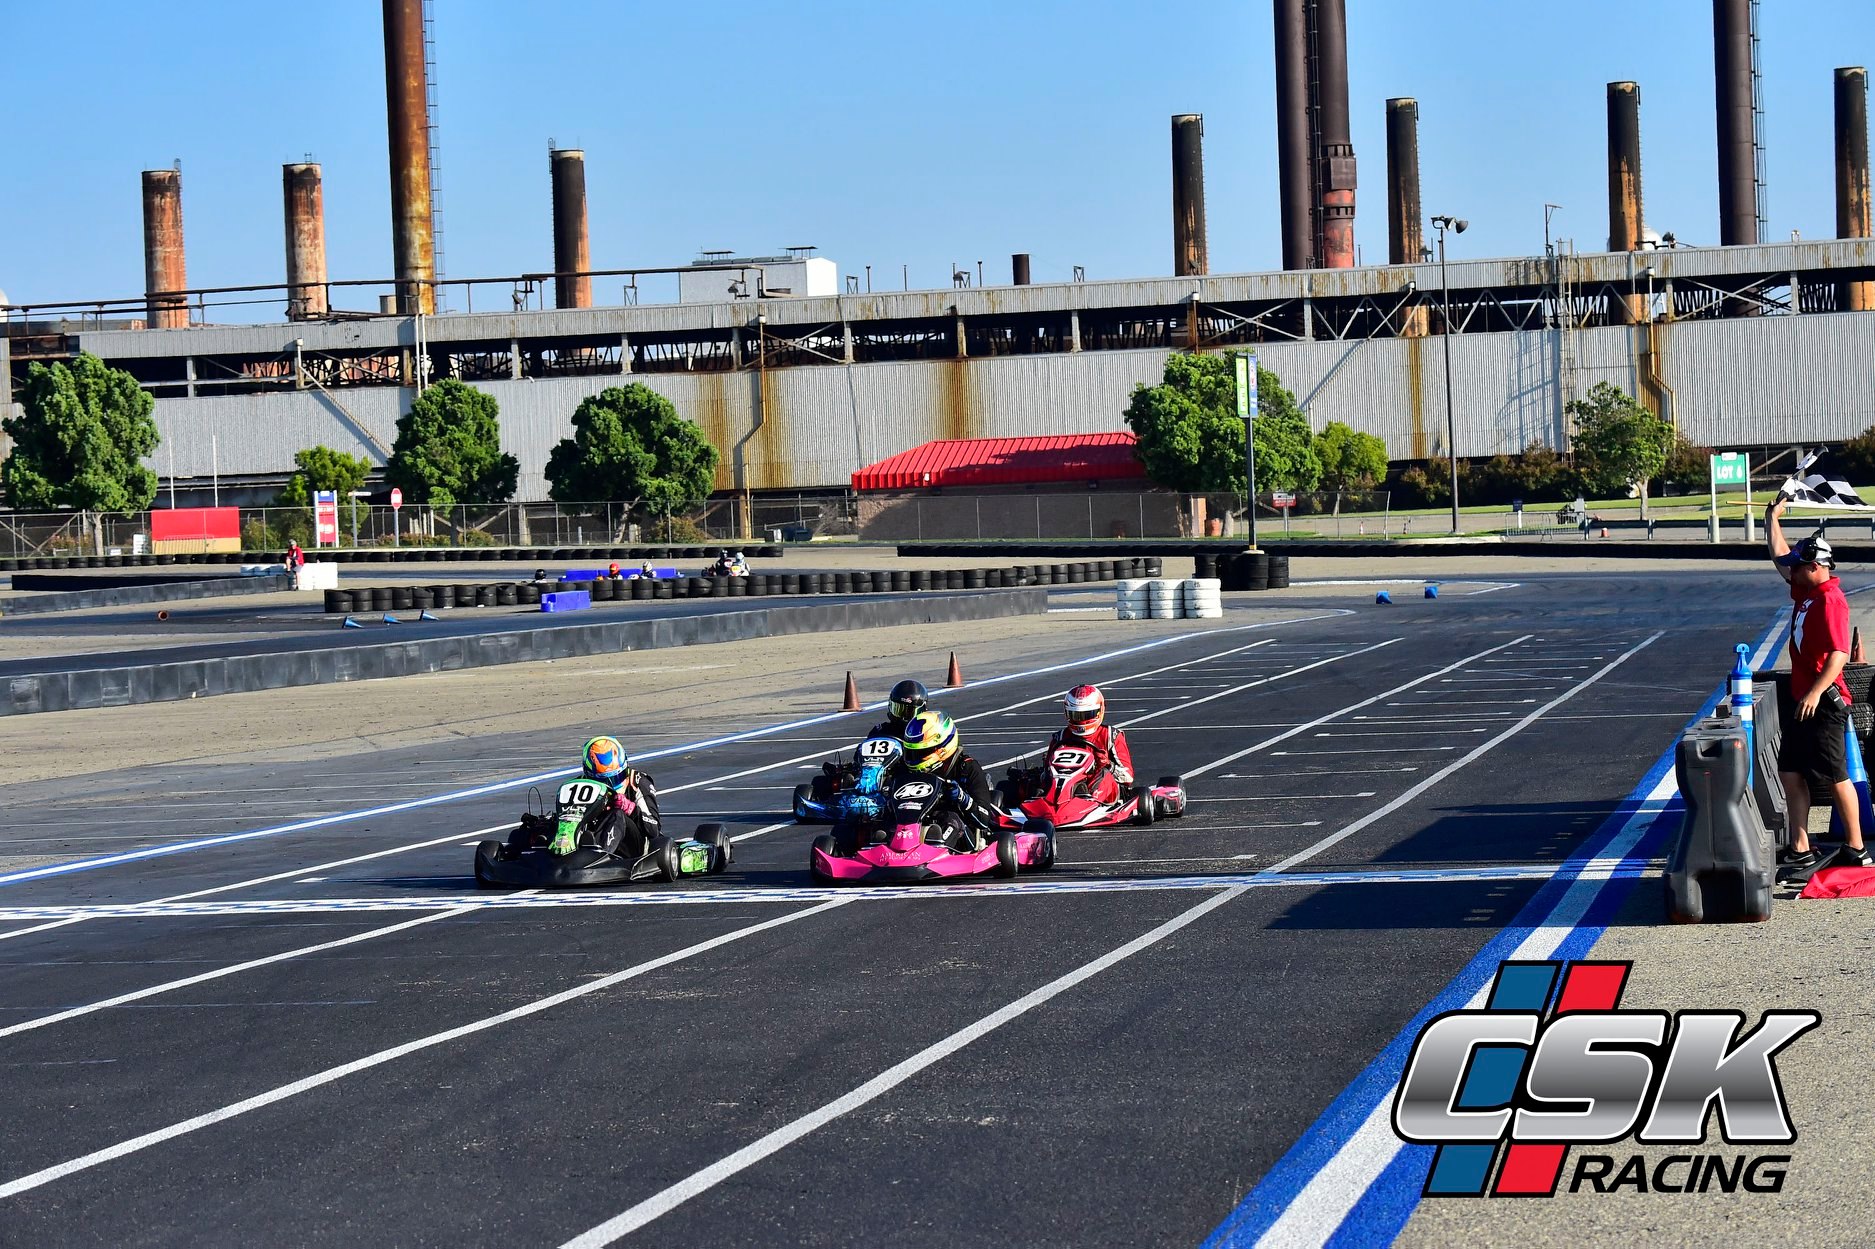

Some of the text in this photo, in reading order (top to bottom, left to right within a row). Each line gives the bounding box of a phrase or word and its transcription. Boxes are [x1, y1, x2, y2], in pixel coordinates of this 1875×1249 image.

[1716, 465, 1733, 479] LOT
[869, 740, 890, 754] 13
[1054, 752, 1087, 764] 21
[568, 784, 594, 804] 10
